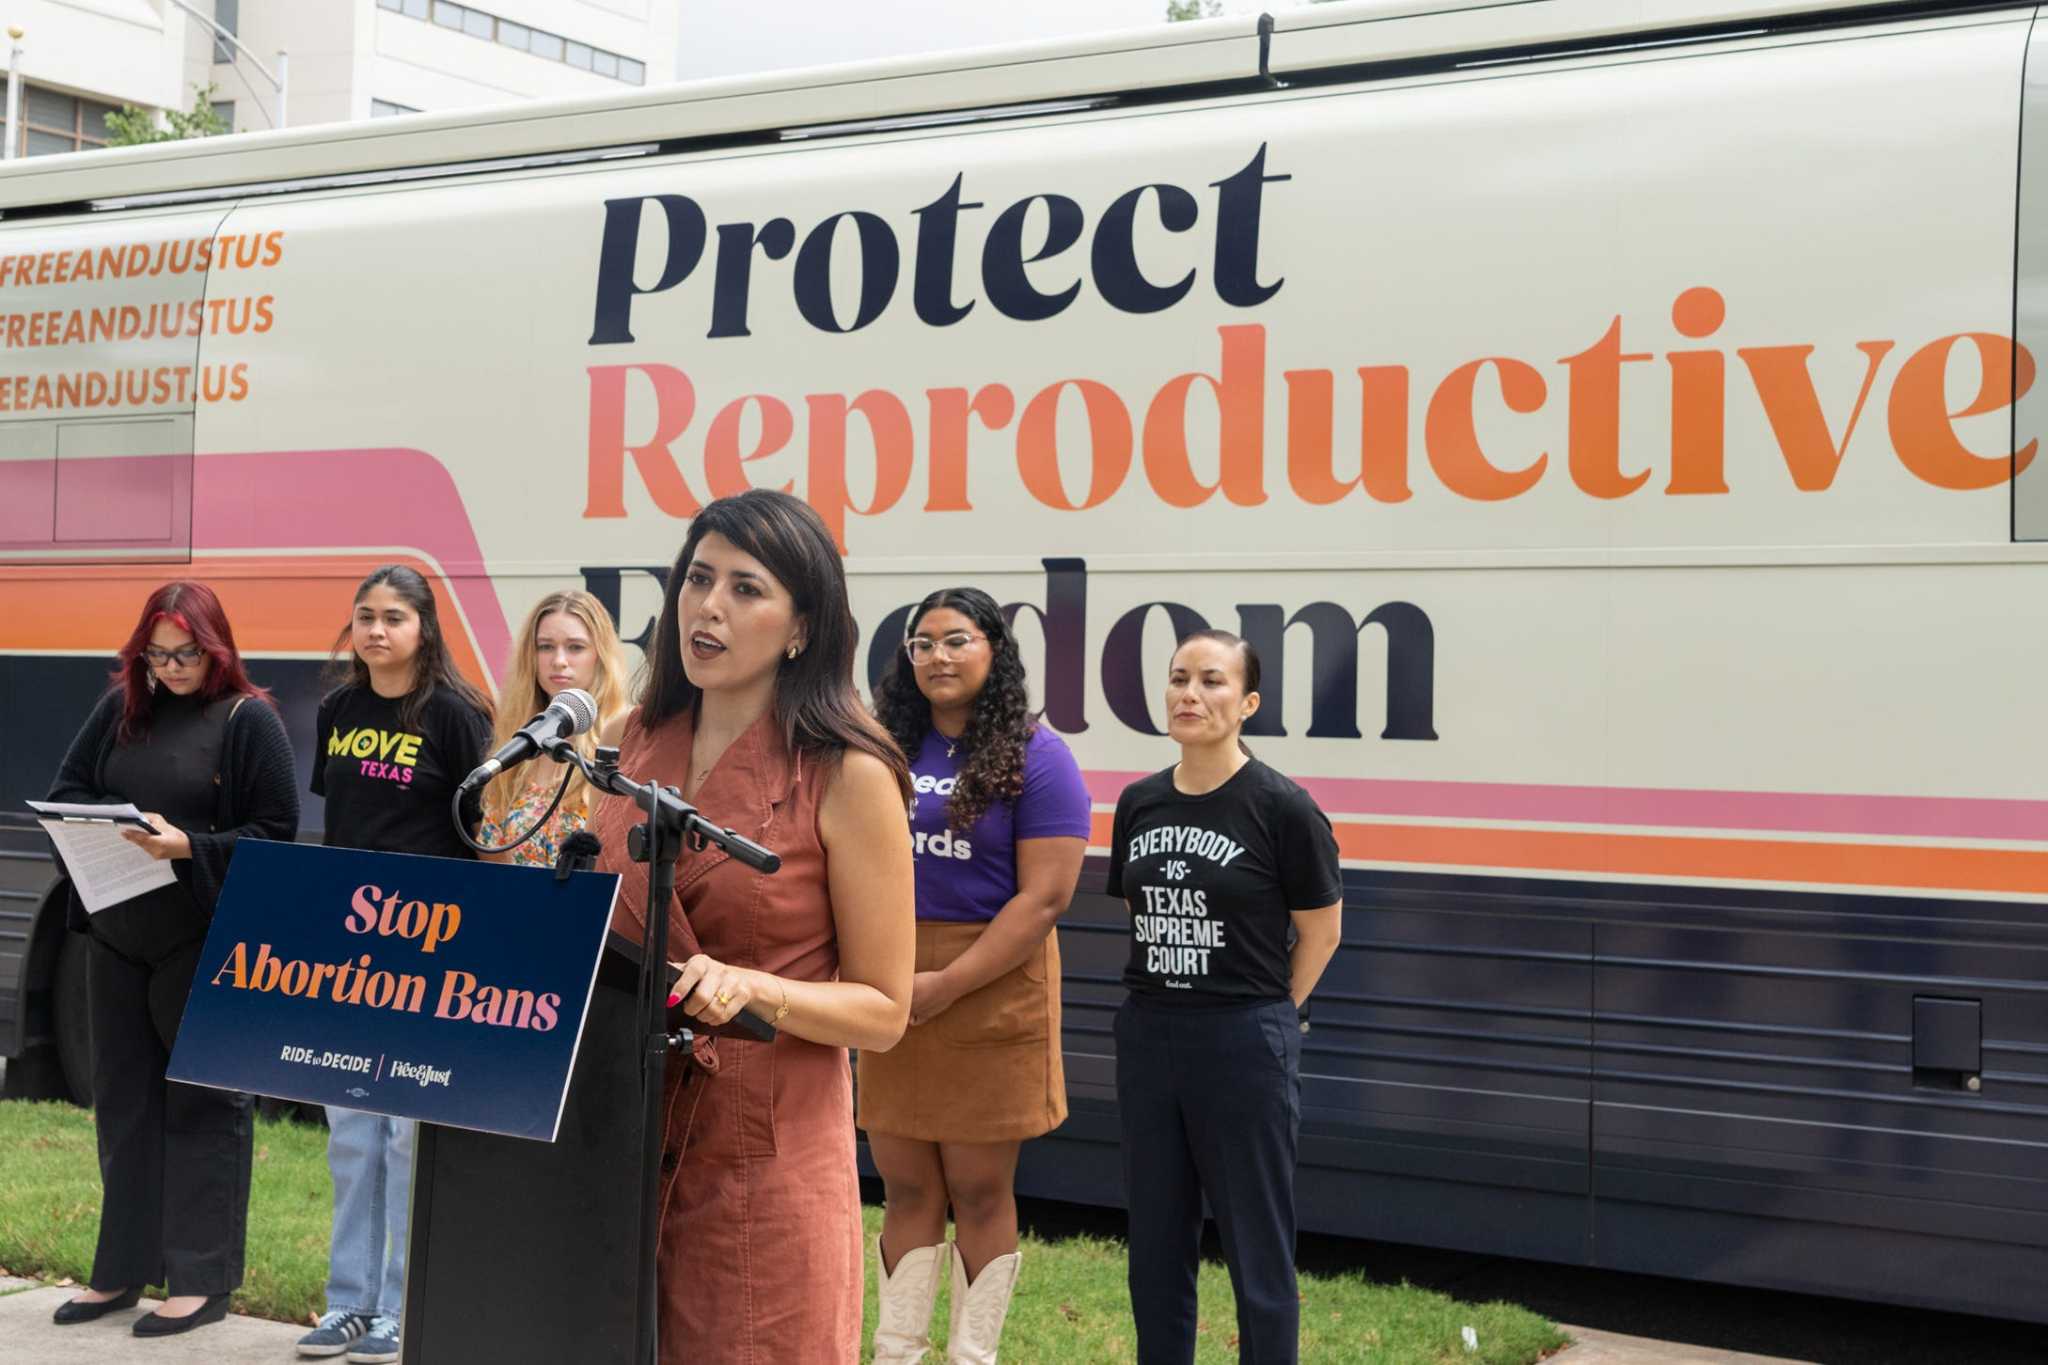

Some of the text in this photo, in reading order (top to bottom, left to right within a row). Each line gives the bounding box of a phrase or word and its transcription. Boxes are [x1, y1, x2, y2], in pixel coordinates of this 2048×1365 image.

[588, 142, 1292, 345] Protect
[582, 287, 2038, 556] Reproductive
[327, 726, 422, 766] MOVE
[359, 760, 413, 783] TEXAS
[911, 828, 972, 860] rds
[1129, 826, 1246, 867] EVERYBODY
[344, 885, 461, 953] Stop
[1142, 886, 1207, 917] TEXAS
[1135, 915, 1226, 947] SUPREME
[1147, 946, 1210, 975] COURT
[211, 942, 561, 1032] Abortion Bans
[280, 1045, 313, 1065] RIDE
[321, 1052, 373, 1073] DECIDE
